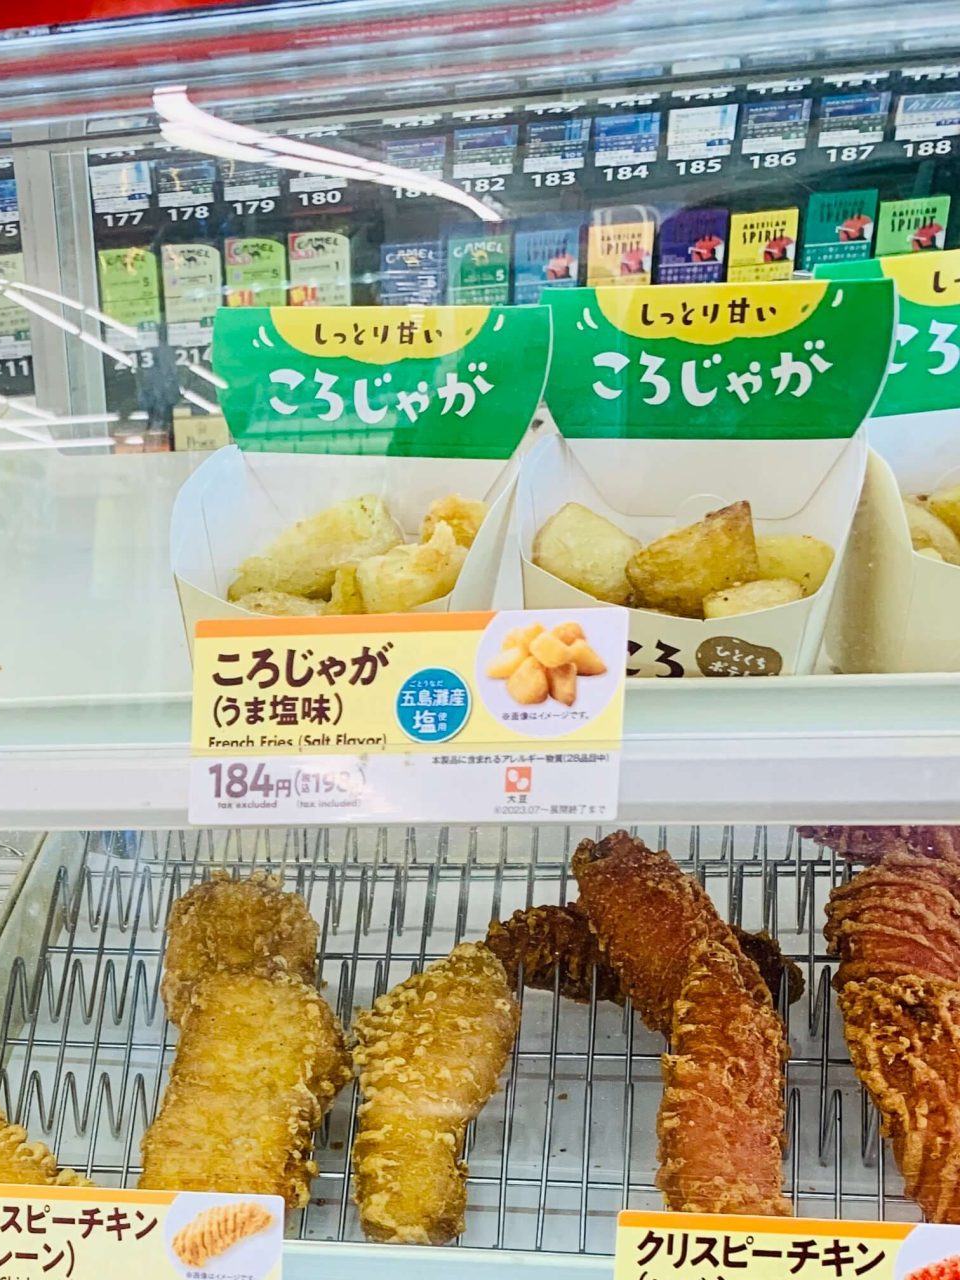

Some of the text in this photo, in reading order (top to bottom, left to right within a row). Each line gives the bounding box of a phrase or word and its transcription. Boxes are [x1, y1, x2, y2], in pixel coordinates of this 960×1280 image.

[826, 145, 875, 163] 187
[902, 140, 952, 158] 188
[676, 158, 722, 176] 185
[750, 152, 797, 169] 186
[531, 171, 576, 188] 183
[603, 164, 649, 182] 184
[461, 177, 506, 194] 182
[298, 191, 342, 206] 180
[167, 205, 209, 221] 178
[232, 200, 275, 216] 179
[103, 211, 143, 227] 177
[453, 241, 504, 259] CAMEL
[641, 298, 778, 328] しっとり甘い
[315, 319, 444, 346] しっとり甘い
[592, 338, 835, 405] ころじゃが
[268, 361, 496, 425] ころじゃが
[212, 641, 395, 689] ころじゃが
[715, 645, 767, 671] ひとくち
[399, 688, 467, 708] 五島灘産
[213, 692, 344, 728] (うま塩味)
[208, 762, 291, 799] 184円
[636, 1229, 886, 1278] クリスピーチキン
